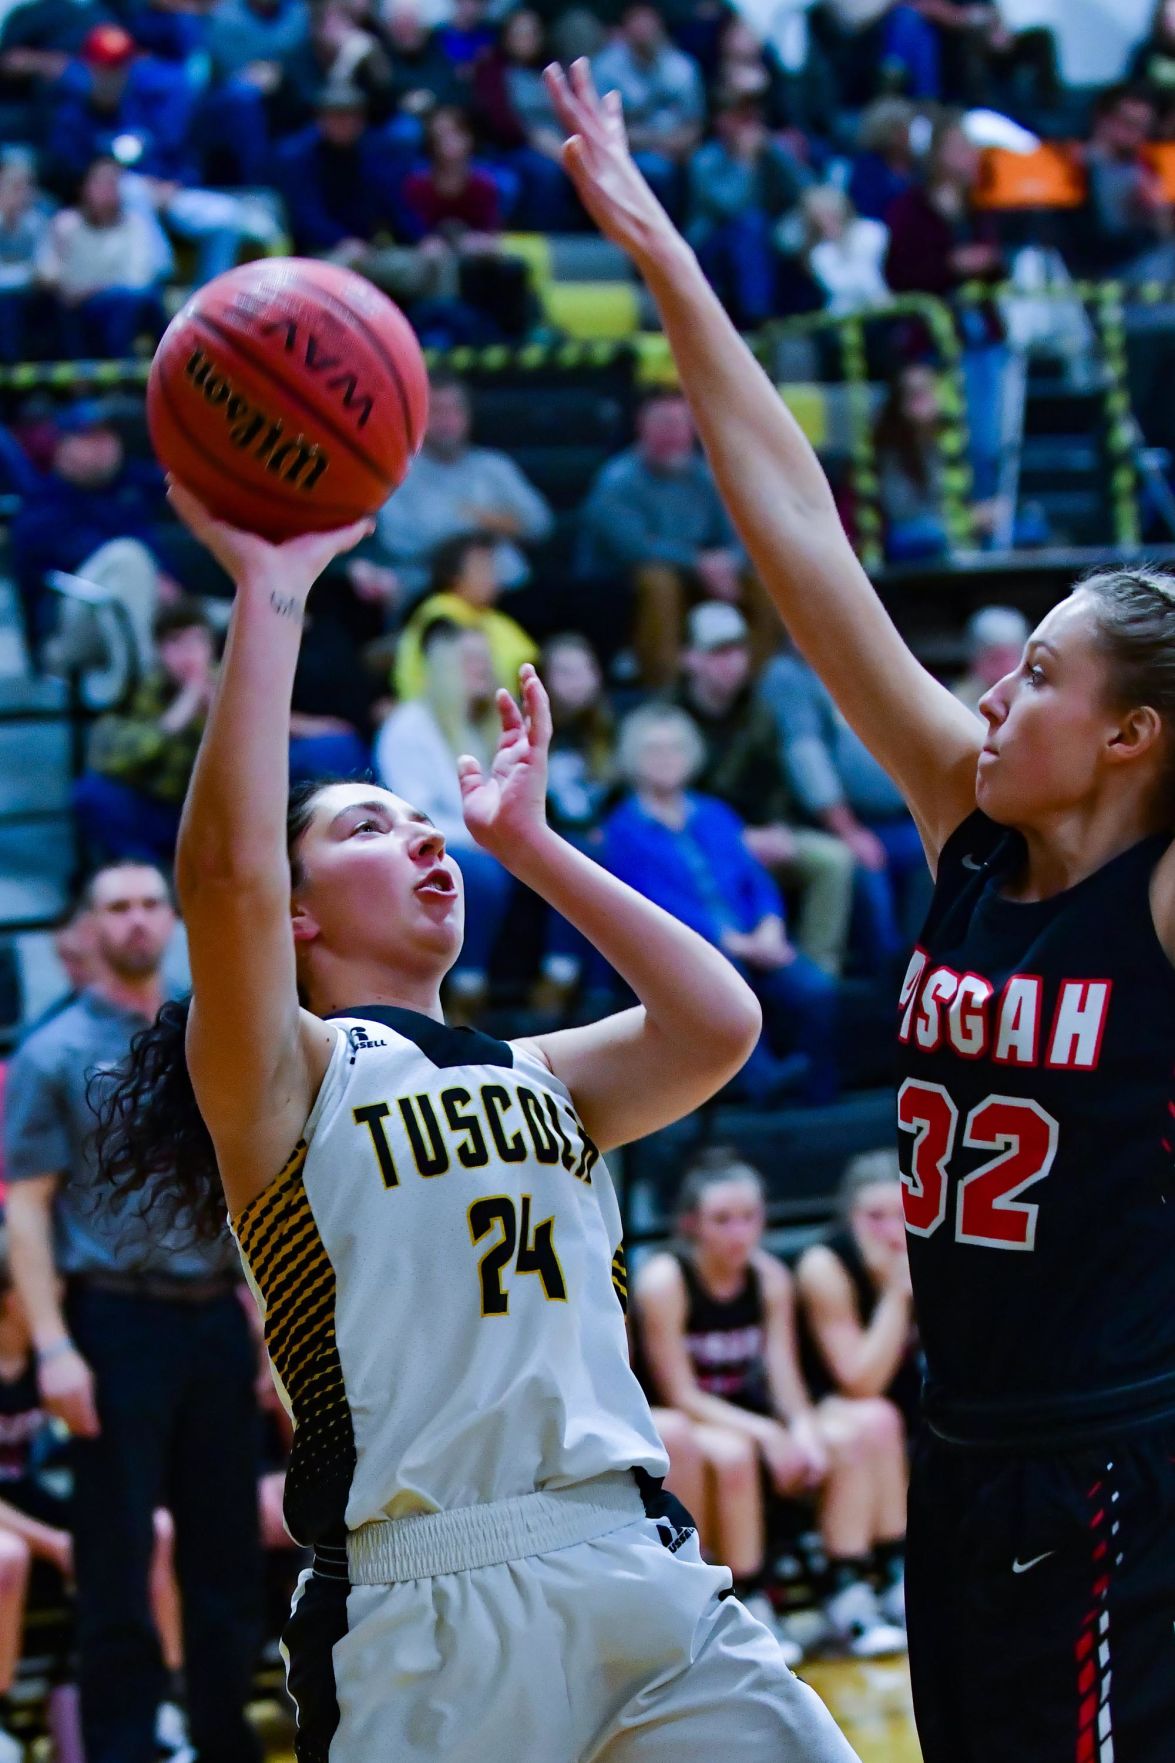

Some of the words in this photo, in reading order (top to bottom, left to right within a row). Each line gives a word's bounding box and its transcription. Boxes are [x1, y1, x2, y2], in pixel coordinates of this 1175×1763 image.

[185, 348, 329, 491] Wilson
[897, 1077, 1060, 1252] 32
[466, 1193, 569, 1318] 24
